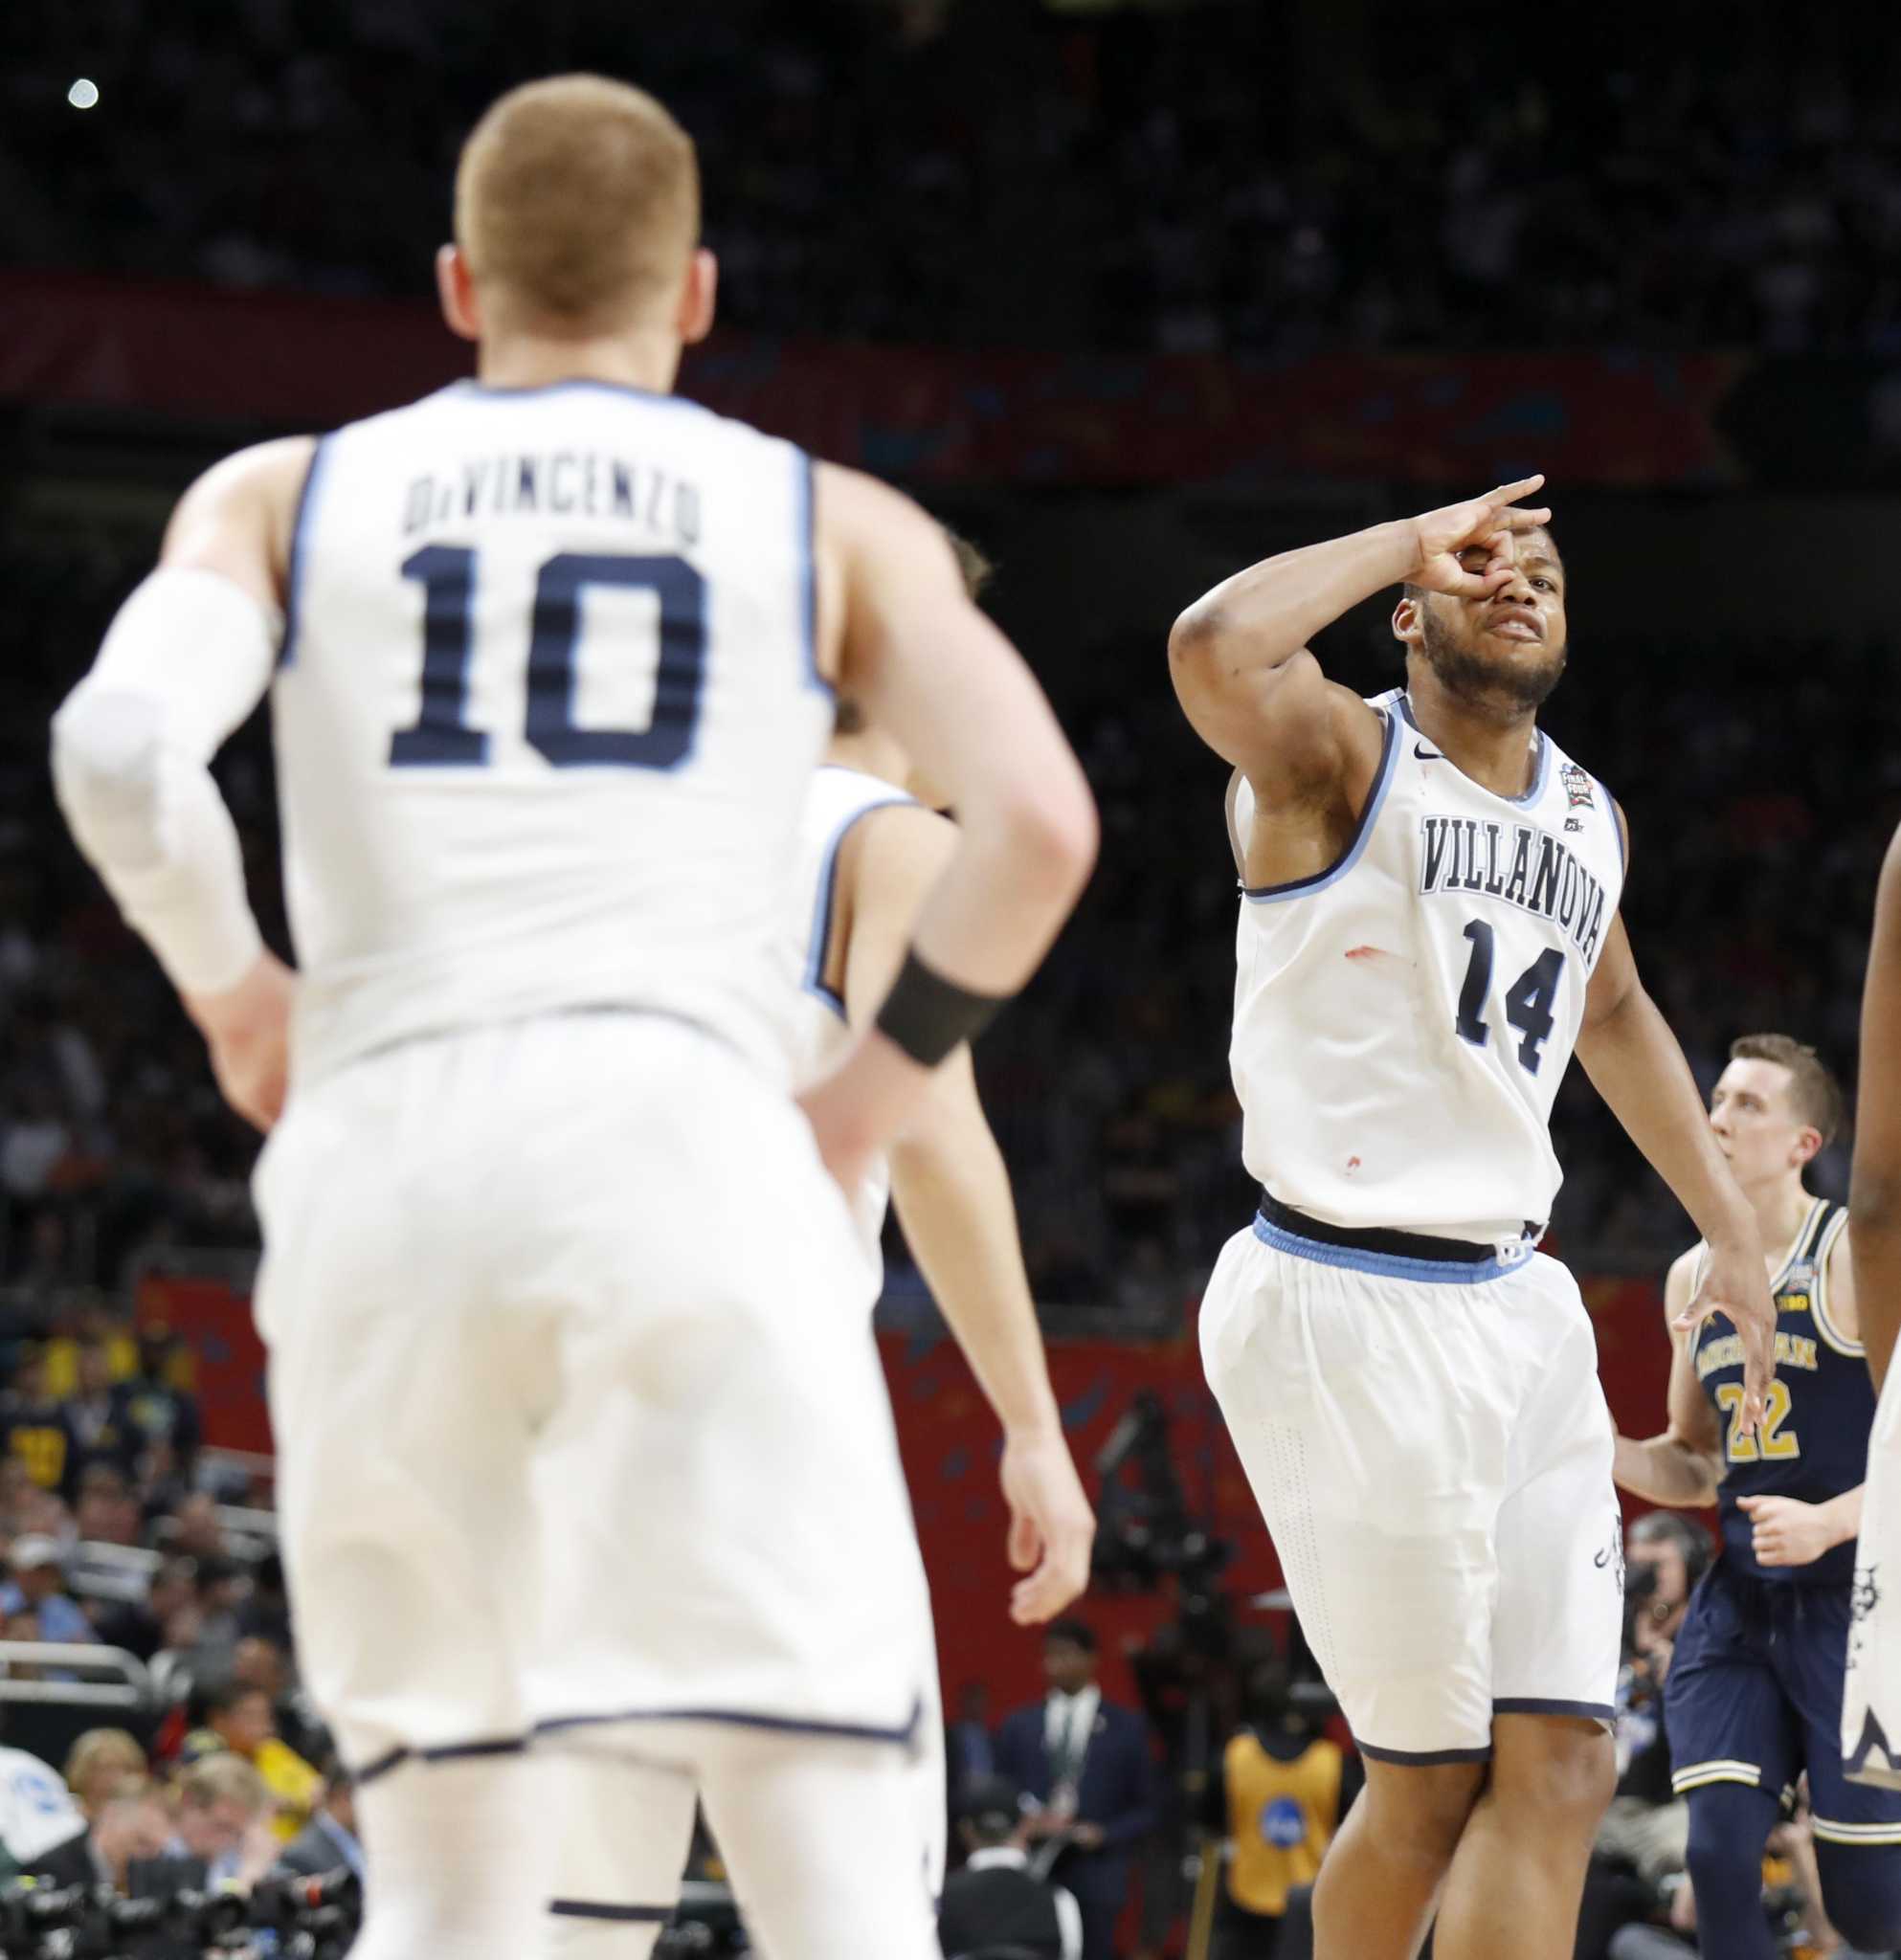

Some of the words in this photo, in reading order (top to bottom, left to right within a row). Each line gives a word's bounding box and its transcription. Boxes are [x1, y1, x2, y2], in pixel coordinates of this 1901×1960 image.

[388, 543, 709, 771] 10
[1420, 815, 1606, 973] VILLANOVA
[1455, 918, 1566, 1078] 14
[1716, 1378, 1800, 1462] 22
